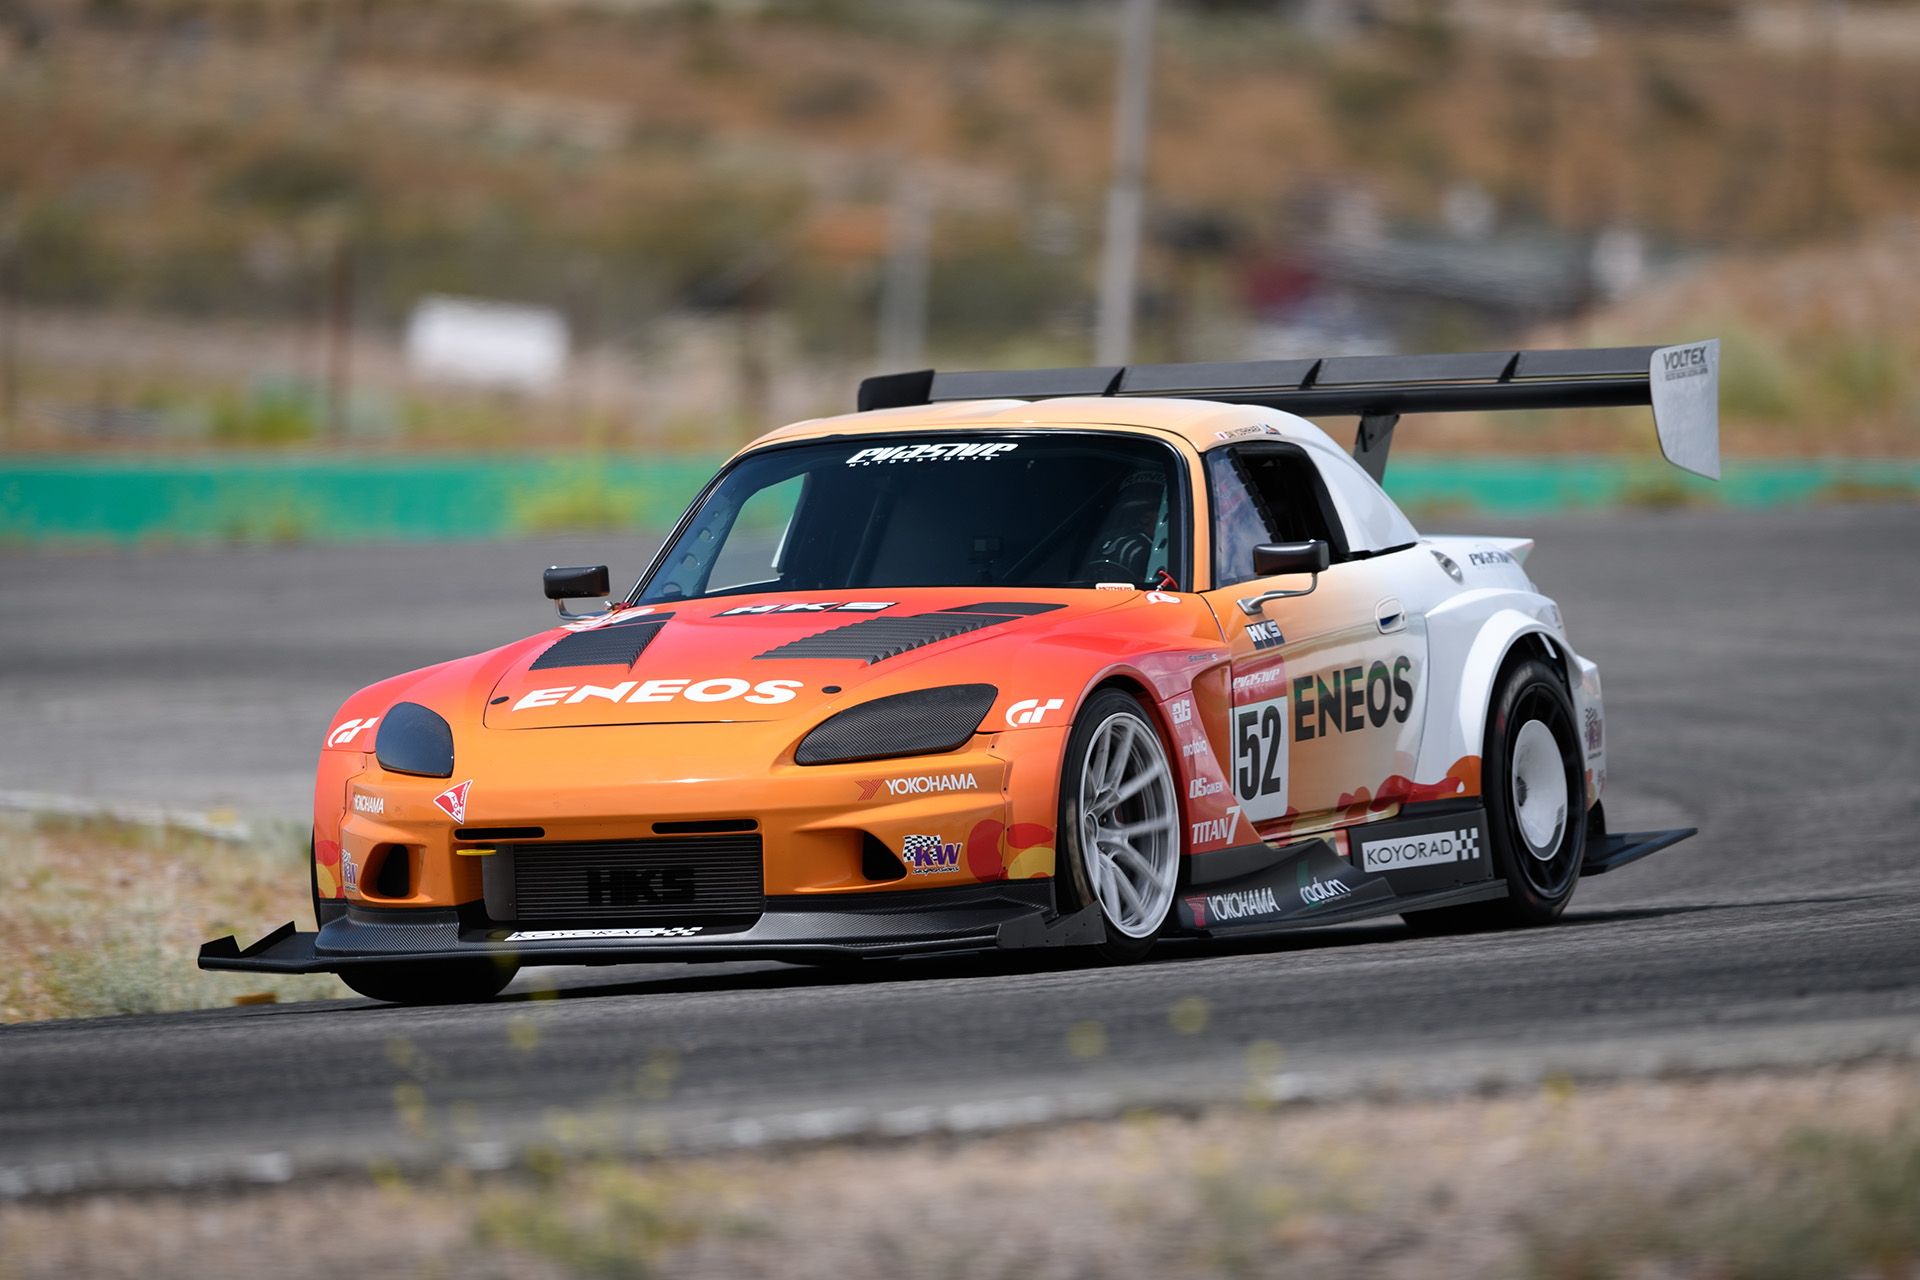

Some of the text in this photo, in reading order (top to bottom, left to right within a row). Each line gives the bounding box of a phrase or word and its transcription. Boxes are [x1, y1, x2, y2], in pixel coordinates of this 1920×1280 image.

[1663, 346, 1707, 370] VOLTEX
[849, 456, 992, 467] MOTORSPORTS
[718, 602, 899, 616] HKS
[1246, 620, 1281, 642] HKS
[511, 678, 804, 712] ENEOS
[1291, 655, 1413, 741] ENEOS
[1238, 705, 1282, 801] 52
[885, 773, 978, 796] YOKOHAMA
[914, 843, 962, 868] KW
[1366, 839, 1453, 866] KOYORAD
[588, 868, 695, 906] HKS
[1207, 887, 1281, 921] YOKOHAMA
